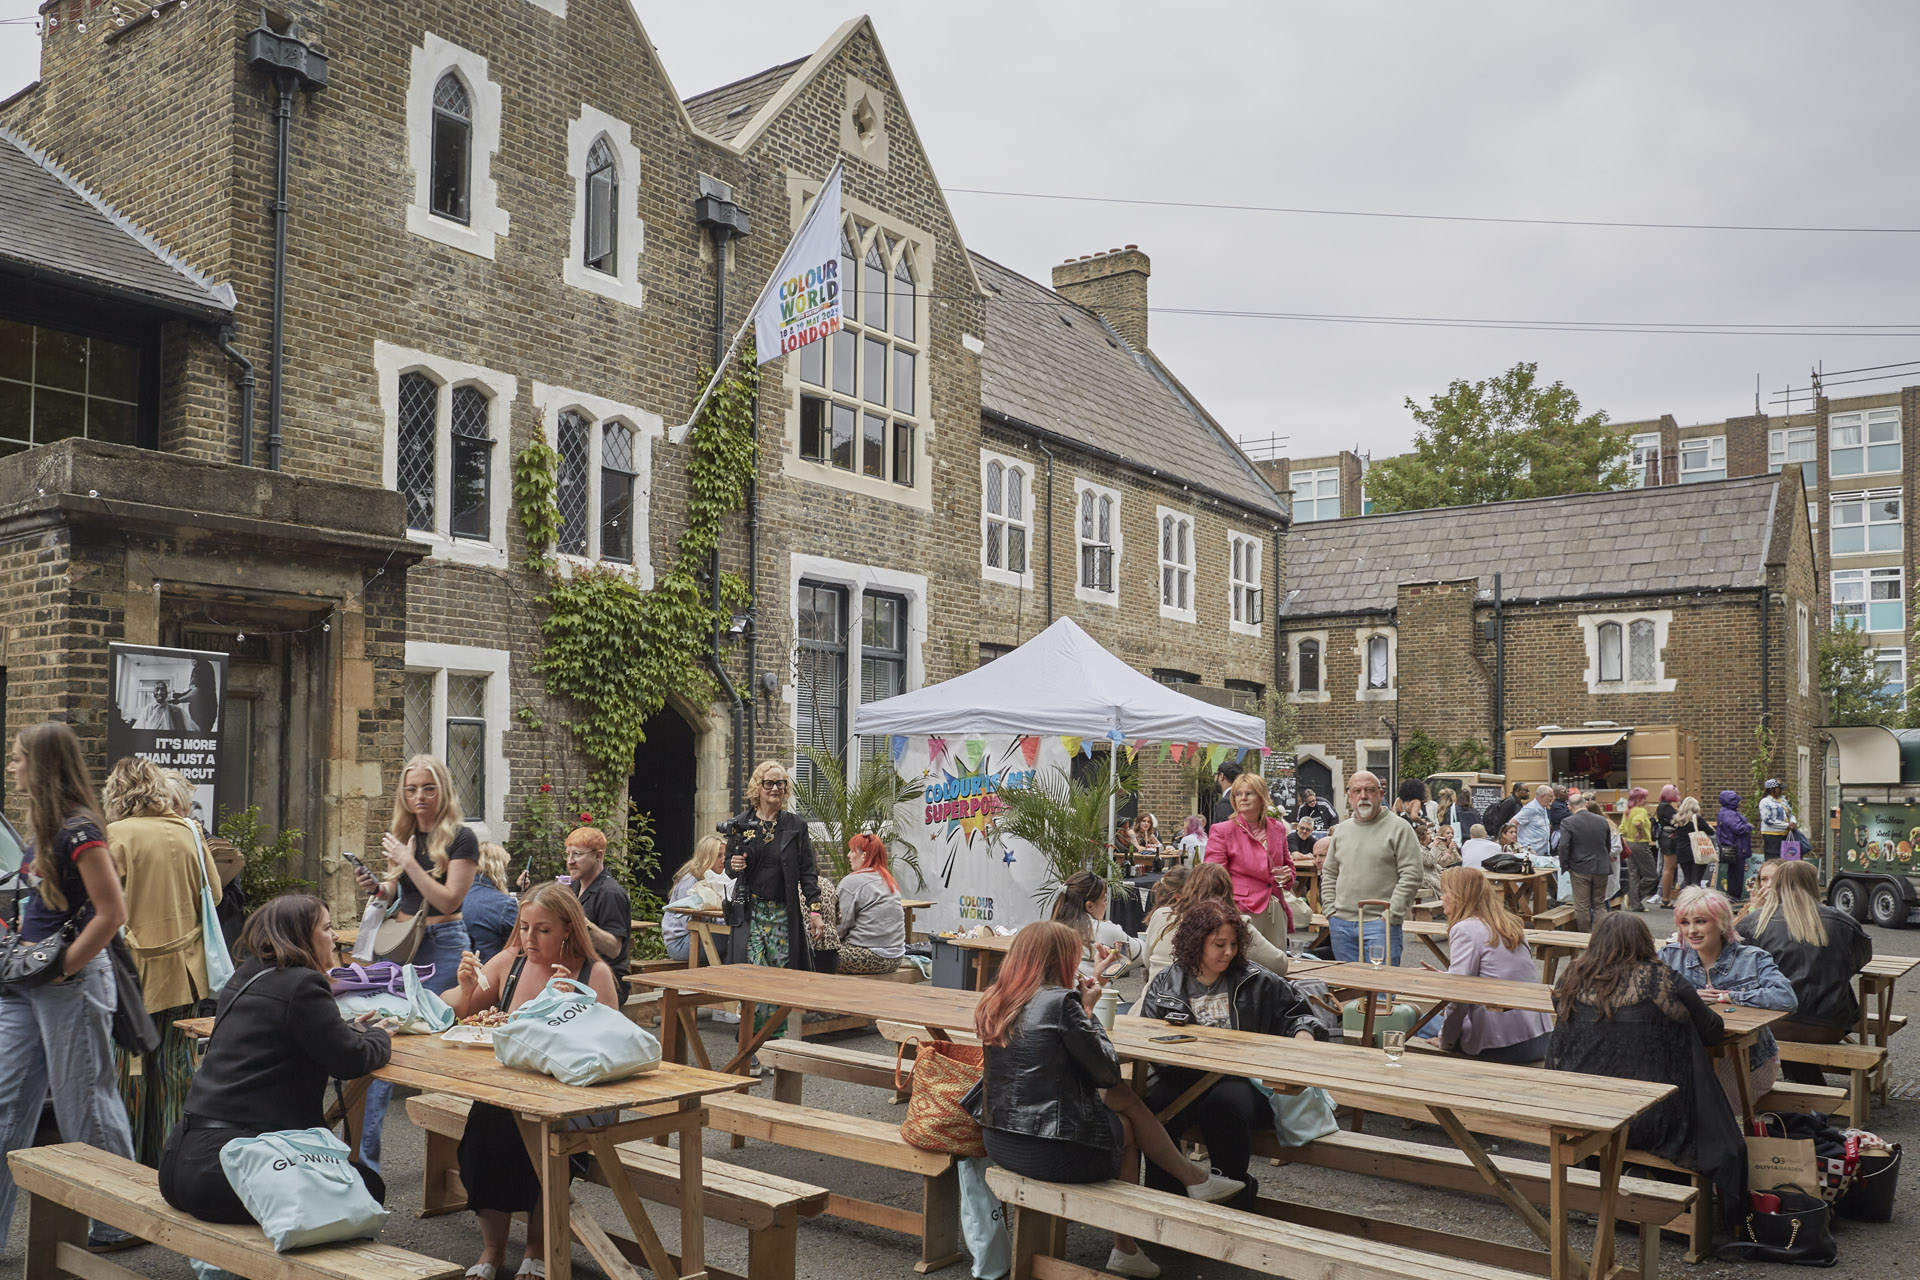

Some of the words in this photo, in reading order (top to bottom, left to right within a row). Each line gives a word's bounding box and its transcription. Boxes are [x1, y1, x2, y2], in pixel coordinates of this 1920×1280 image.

[779, 259, 838, 301] COLOUR
[779, 280, 839, 321] WORLD
[780, 330, 788, 339] 18
[796, 322, 804, 331] 19
[806, 315, 820, 328] MAY
[780, 315, 840, 355] LONDON
[155, 738, 182, 749] IT'S
[183, 739, 217, 750] MORE
[134, 752, 171, 764] THAN
[172, 753, 204, 765] JUST
[206, 754, 215, 765] A
[174, 767, 215, 779] IRCUT
[925, 776, 982, 804] COLOUR
[985, 773, 1002, 794] IS
[1006, 769, 1037, 790] MY
[959, 895, 994, 910] COLOUR
[959, 907, 994, 921] WORLD
[547, 1003, 594, 1026] GLOW
